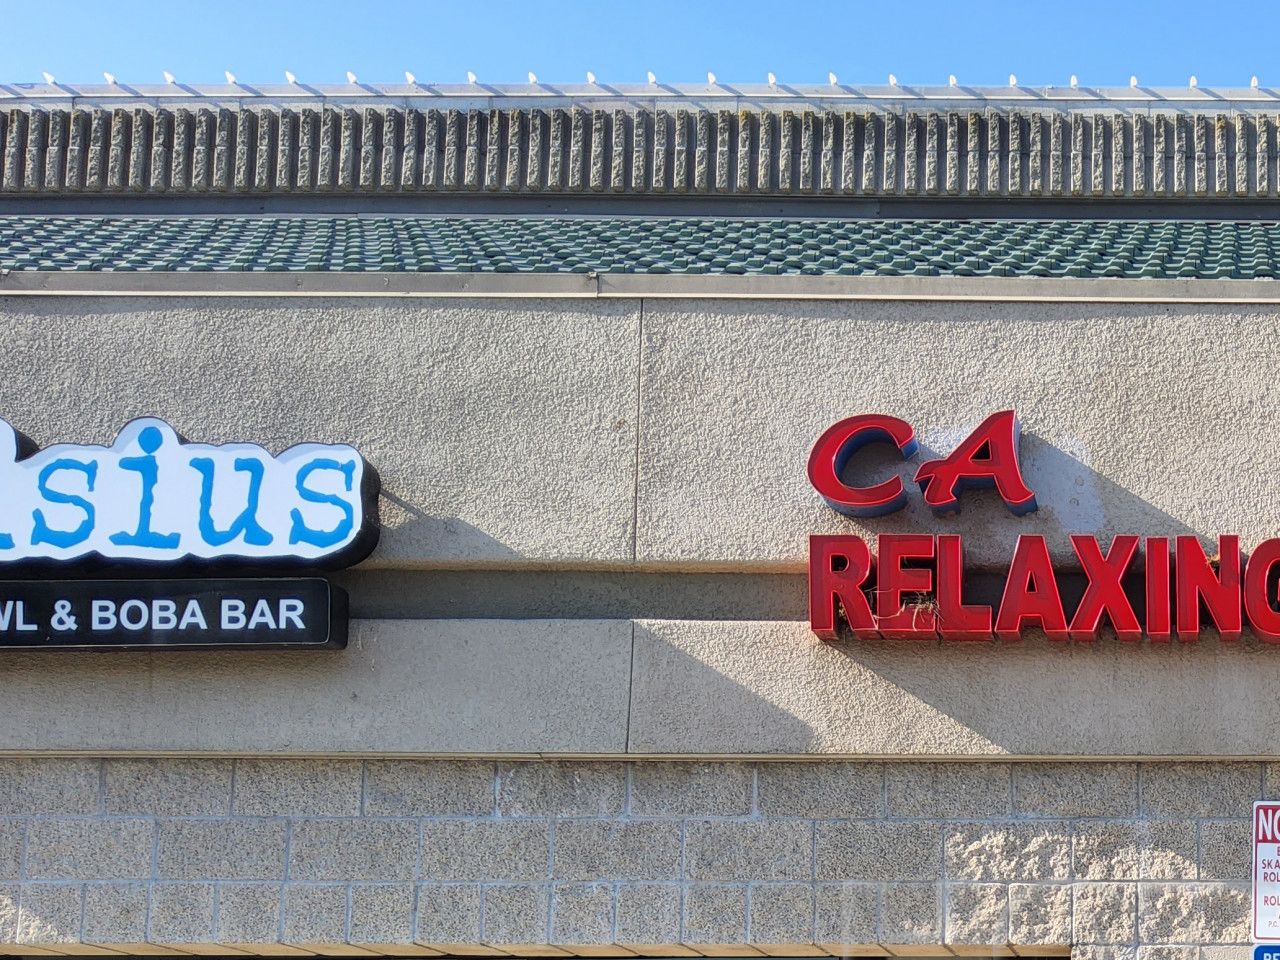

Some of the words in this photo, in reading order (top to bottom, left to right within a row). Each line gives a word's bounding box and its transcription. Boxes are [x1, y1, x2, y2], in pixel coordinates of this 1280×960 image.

[0, 427, 356, 549] sius
[807, 410, 1036, 512] CA
[50, 599, 79, 632] &
[91, 599, 207, 632] BOBA
[220, 599, 305, 631] BAR
